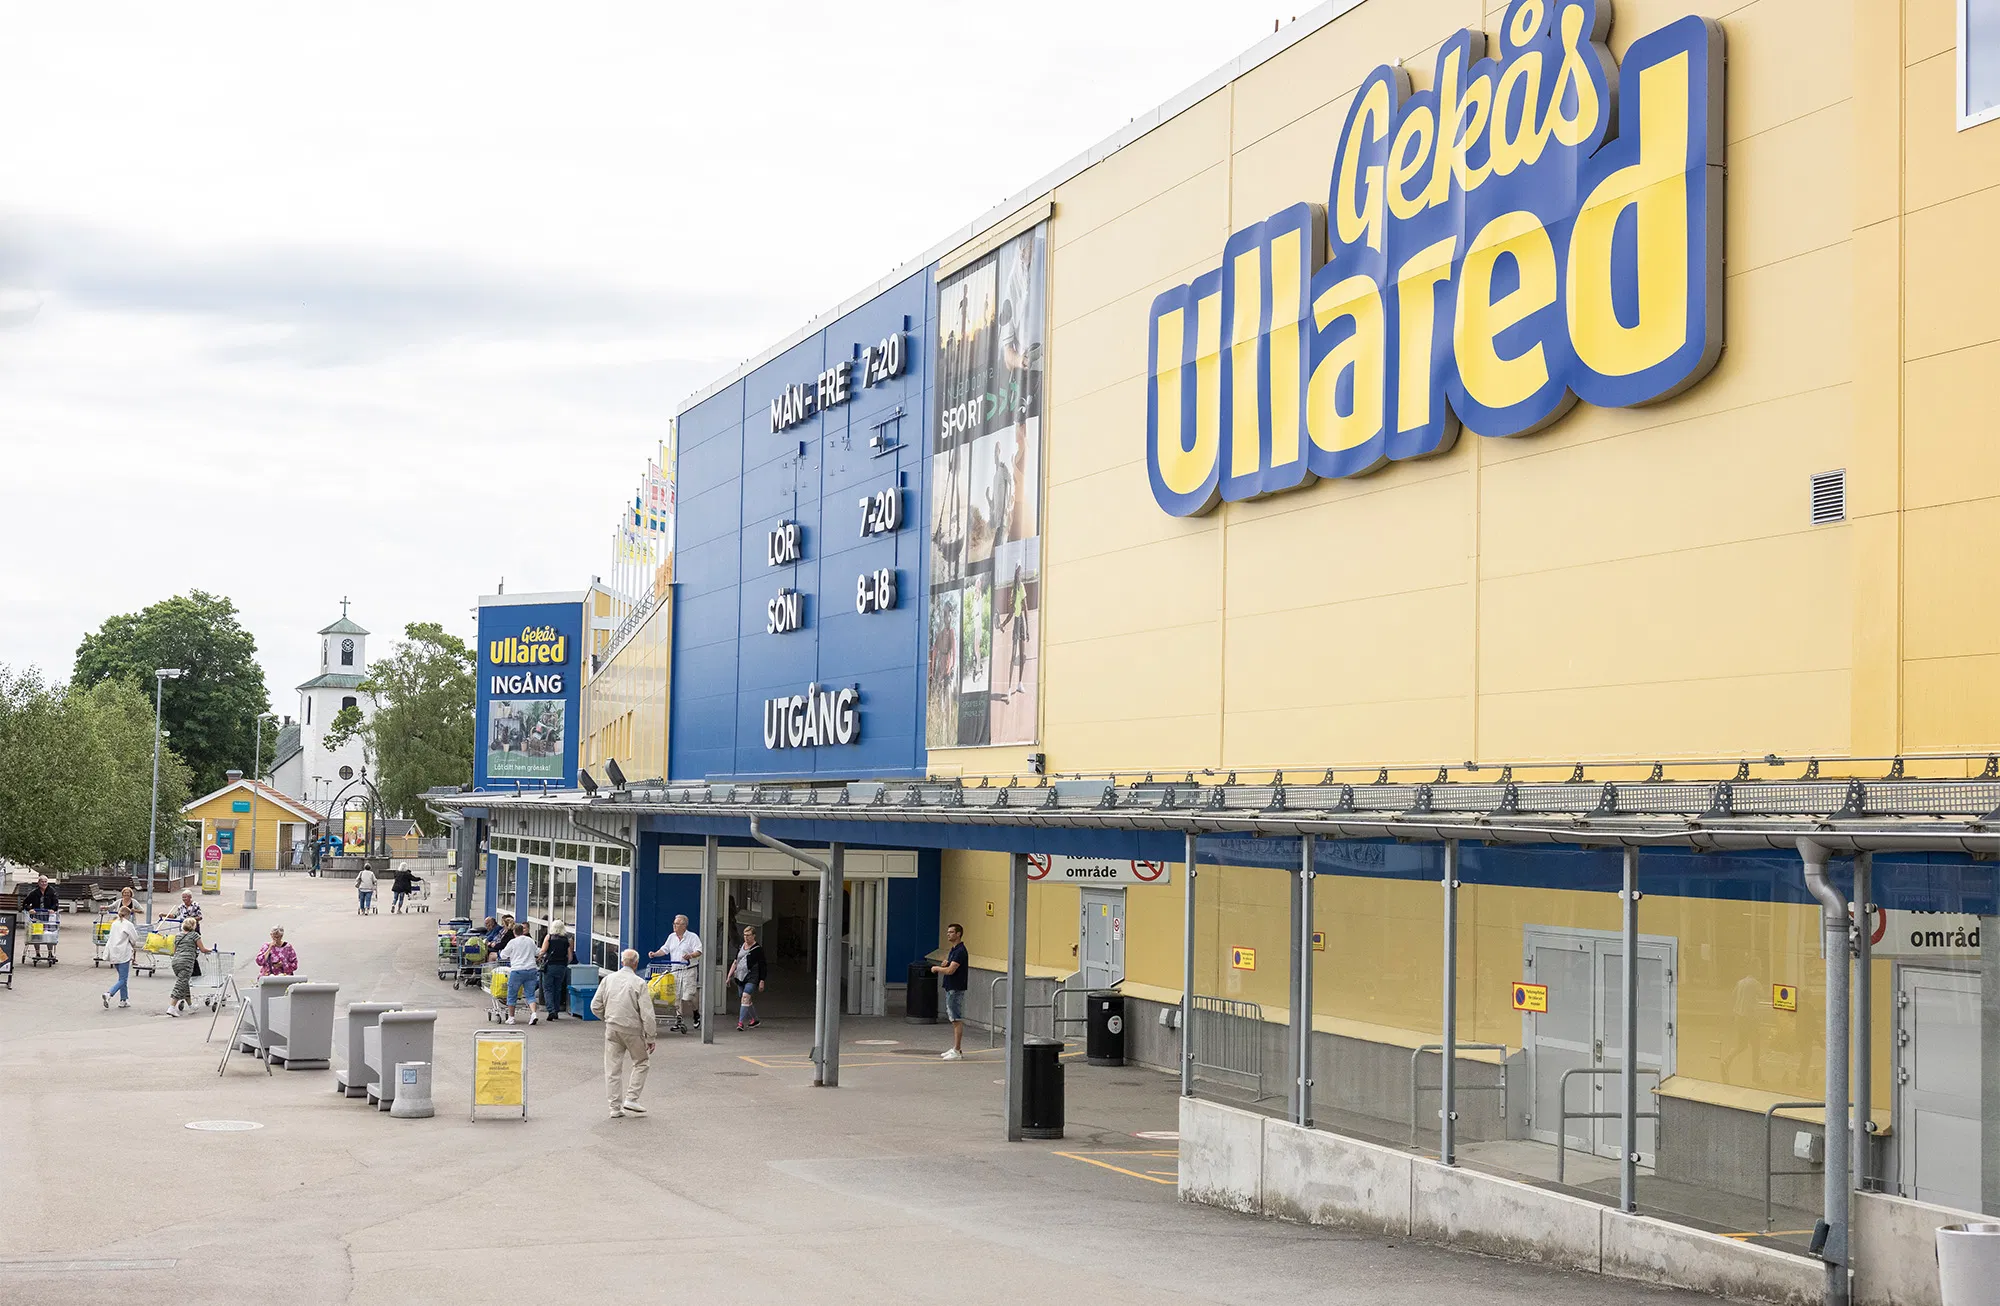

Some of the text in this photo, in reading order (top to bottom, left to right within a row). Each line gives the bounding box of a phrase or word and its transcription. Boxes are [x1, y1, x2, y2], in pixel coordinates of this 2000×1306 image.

[1336, 0, 1599, 253] Gekås
[1157, 49, 1689, 495] Ullared
[817, 361, 847, 411] FRE
[862, 332, 901, 389] 7-20
[941, 394, 984, 439] SPORT
[767, 487, 897, 567] LÖR 7-20
[766, 567, 891, 634] SÖN 8-18
[490, 636, 565, 664] Ullared
[521, 626, 556, 644] Gekås
[490, 672, 562, 694] INGÅNG
[763, 682, 854, 750] UTGÅNG
[1066, 865, 1117, 878] område
